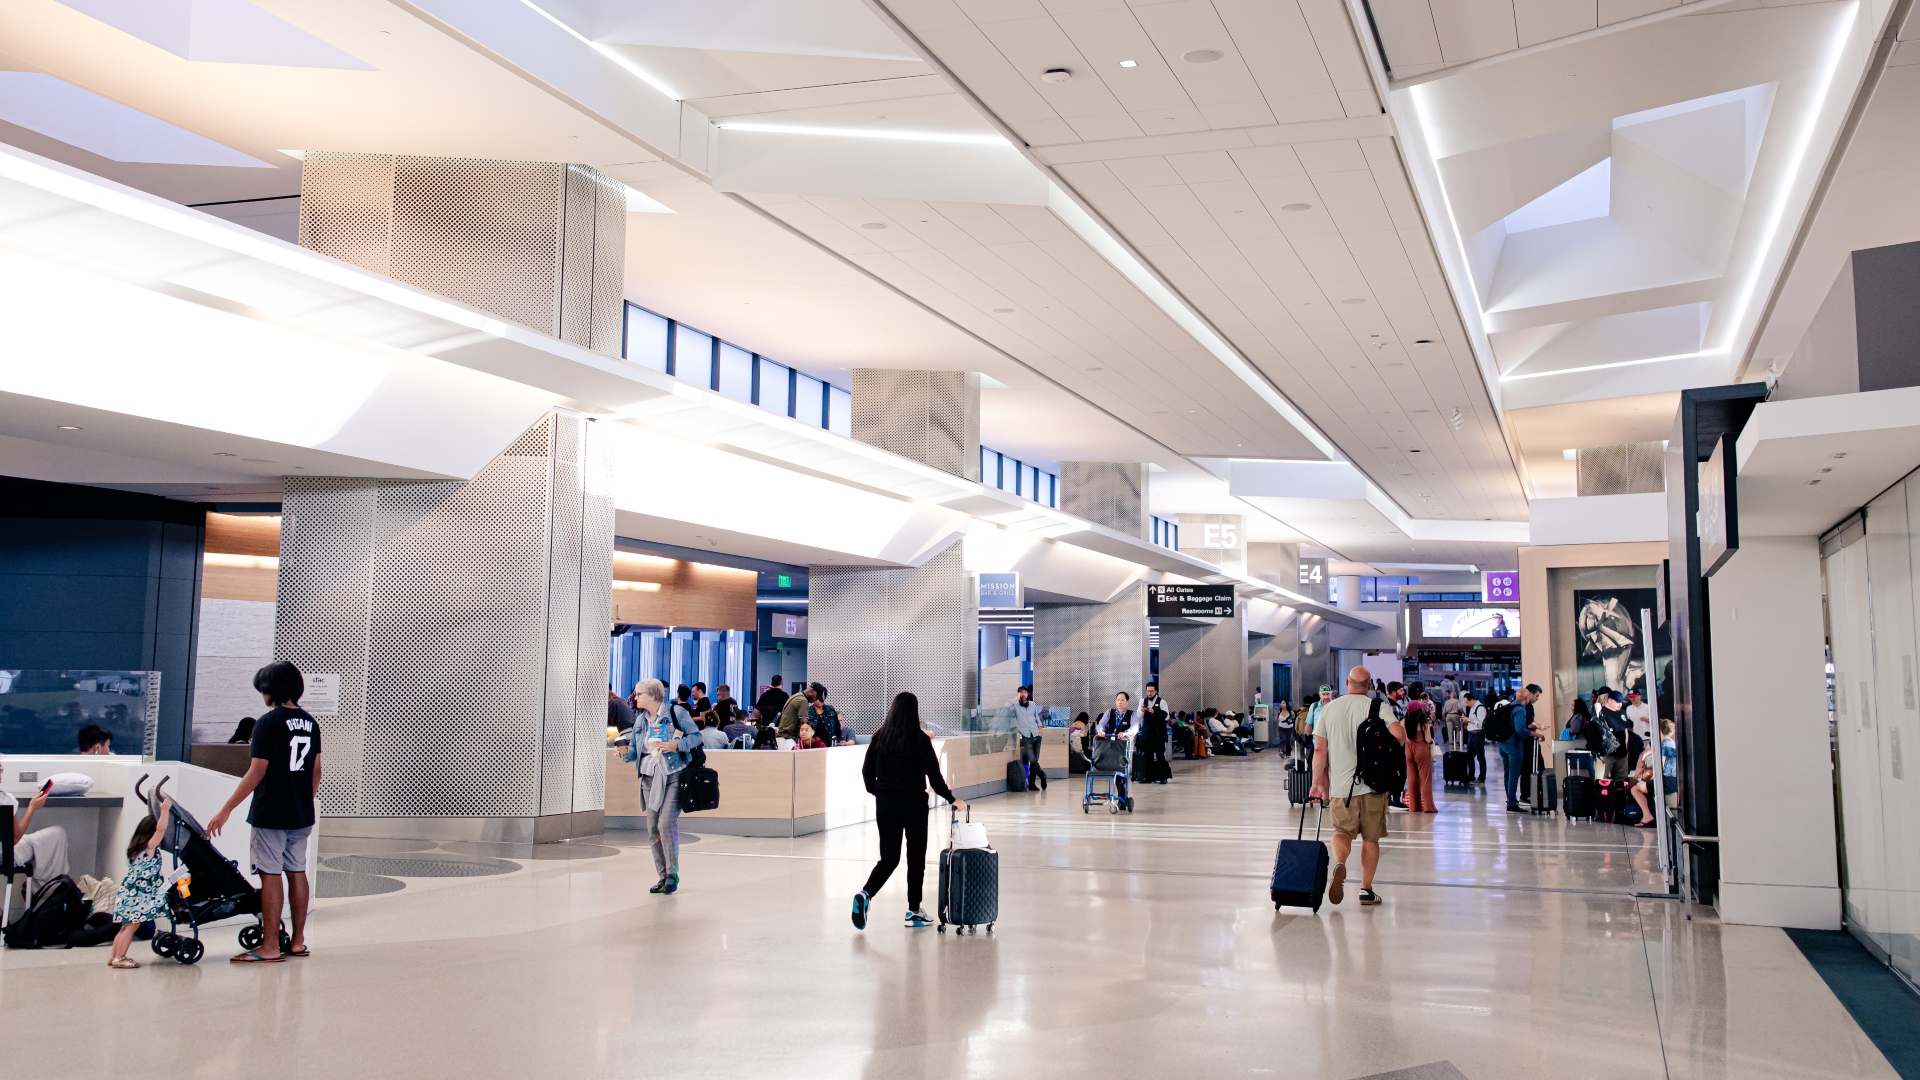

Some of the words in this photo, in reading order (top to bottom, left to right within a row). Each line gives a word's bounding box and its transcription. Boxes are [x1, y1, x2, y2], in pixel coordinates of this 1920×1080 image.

[1205, 524, 1237, 548] E5
[1300, 564, 1323, 584] E4
[980, 582, 1015, 590] MISSION
[1187, 595, 1213, 603] Baggage
[286, 718, 313, 733] OHTANI
[289, 735, 311, 772] 17
